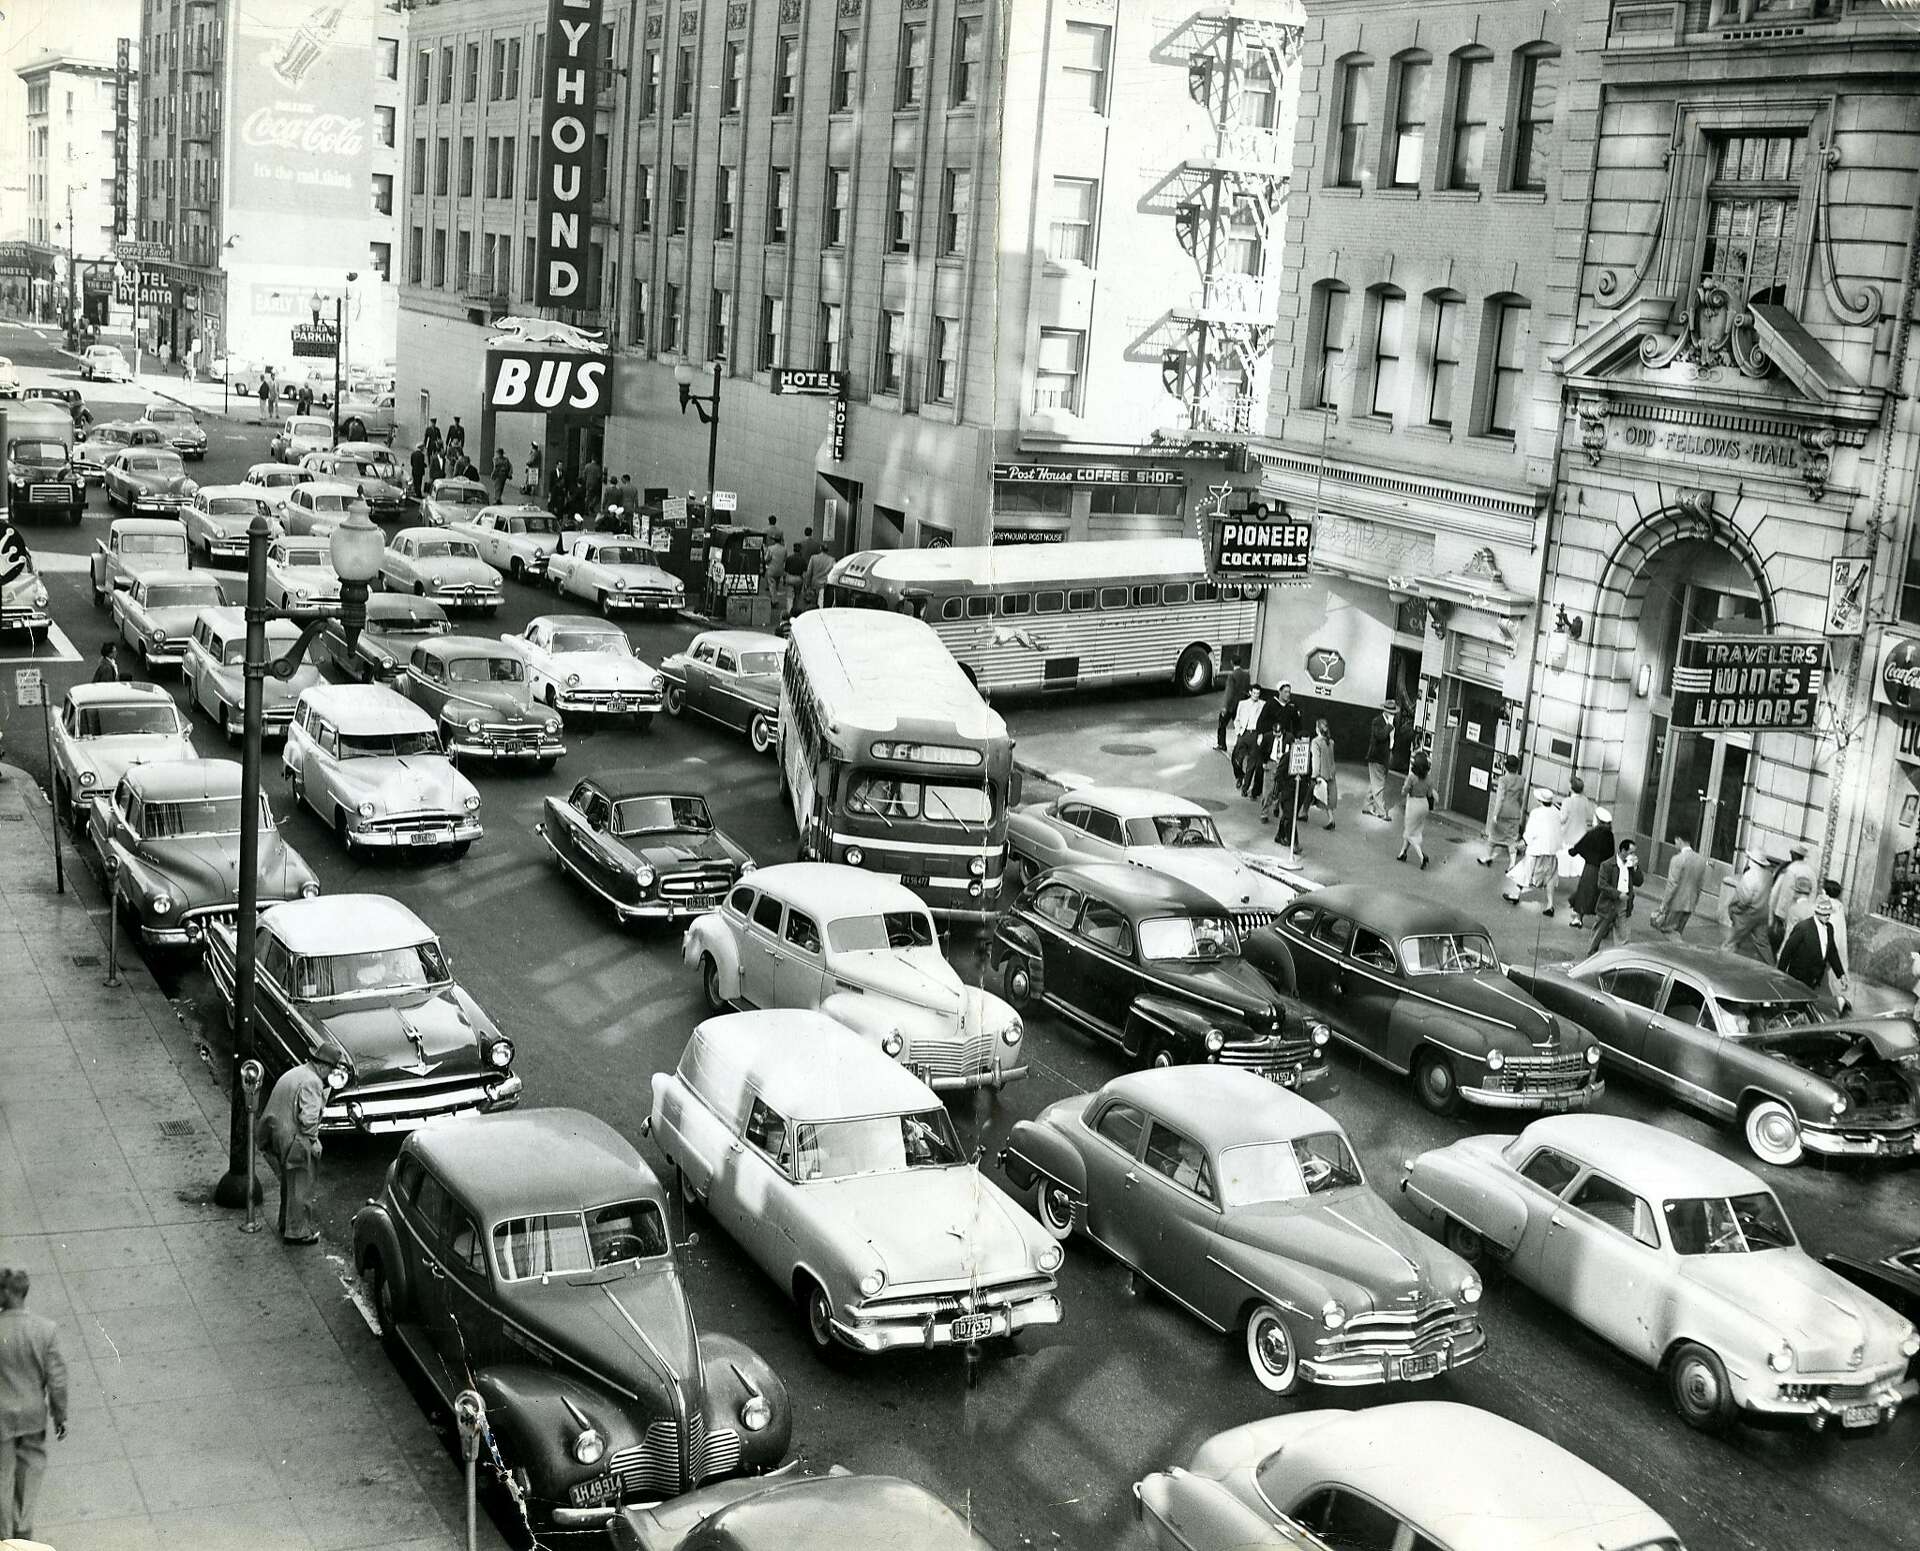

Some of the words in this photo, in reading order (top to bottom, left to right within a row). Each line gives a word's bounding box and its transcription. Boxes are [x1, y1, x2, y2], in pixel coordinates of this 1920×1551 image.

[117, 39, 129, 117] HOTEL
[242, 106, 366, 156] Coca-Cola
[549, 0, 591, 297] YHOUND
[115, 126, 128, 234] ATLANTA
[492, 358, 606, 409] BUS
[780, 371, 840, 387] HOTEL
[834, 401, 846, 458] HOTEL
[1625, 426, 1656, 446] ODD
[1666, 432, 1741, 460] FELLOWS
[1749, 443, 1799, 469] HALL
[1009, 466, 1035, 480] Post
[1036, 467, 1073, 481] House
[1077, 469, 1130, 482] COFFEE
[1136, 471, 1174, 483] SHOP
[1223, 524, 1309, 548] PIONEER
[1221, 552, 1307, 567] COCKTAILS
[1705, 644, 1819, 665] TRAVELERS
[1713, 667, 1802, 696] WINES
[1693, 698, 1811, 727] LIQUORS
